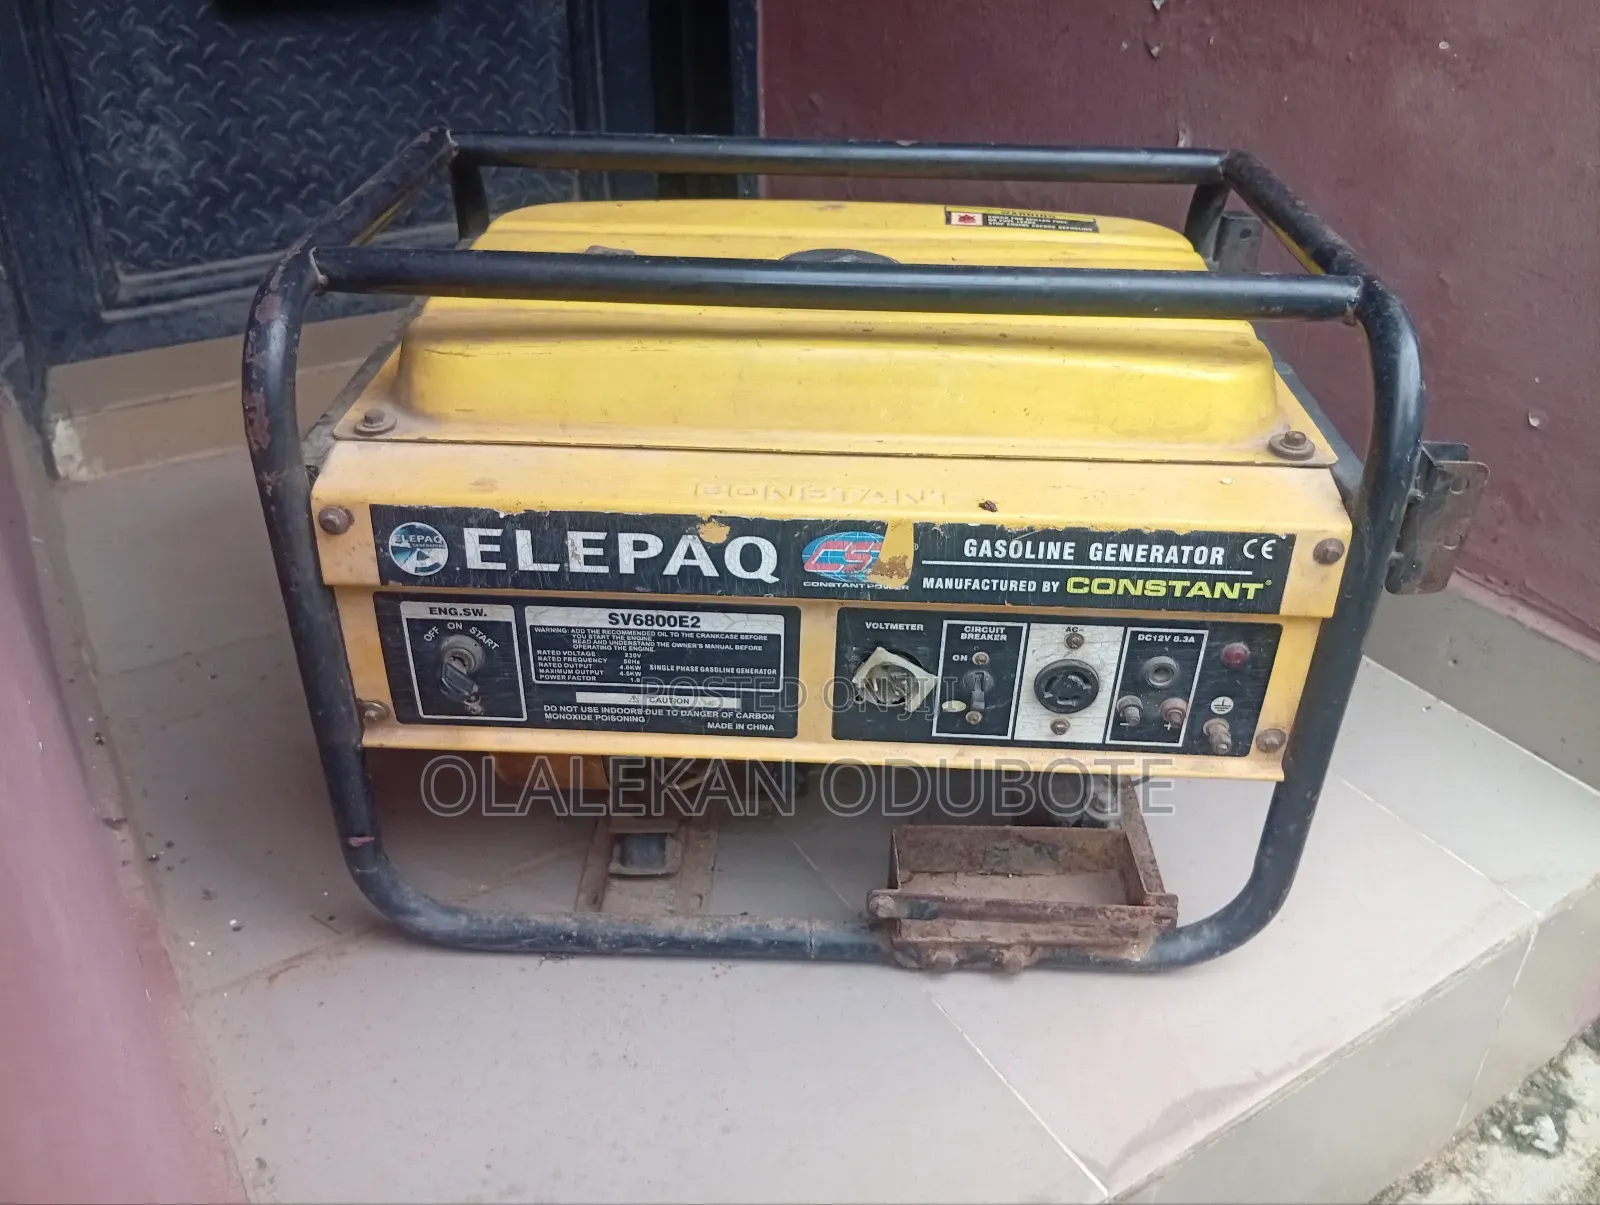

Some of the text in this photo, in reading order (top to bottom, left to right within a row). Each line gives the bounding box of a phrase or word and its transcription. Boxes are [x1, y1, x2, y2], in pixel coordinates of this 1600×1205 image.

[395, 534, 443, 544] ELEPAQ
[463, 527, 780, 584] ELEPAQ
[963, 538, 1225, 566] GASOLINE GENERATOR
[922, 576, 1036, 593] MANUFACTURED
[1042, 580, 1060, 594] BY
[428, 606, 488, 617] ENG.SW.
[608, 612, 701, 628] SV6800E2
[865, 622, 924, 631] VOLTMETER
[964, 626, 1006, 634] CIRCUIT
[423, 622, 500, 650] OFF ON START
[602, 629, 656, 637] RECOMMENDED
[960, 632, 1008, 641] BREAKER
[1137, 633, 1196, 644] DC12V 8.3A
[700, 666, 735, 674] GASOLINE
[736, 667, 777, 676] GENERATOR
[649, 696, 690, 704] CAUTION
[544, 712, 646, 722] MONOXIDE POISONING
[602, 706, 643, 714] INDOORS
[645, 708, 664, 716] DUE
[680, 710, 719, 718] DANGER
[736, 712, 775, 720] CARBON
[707, 722, 734, 730] MADE
